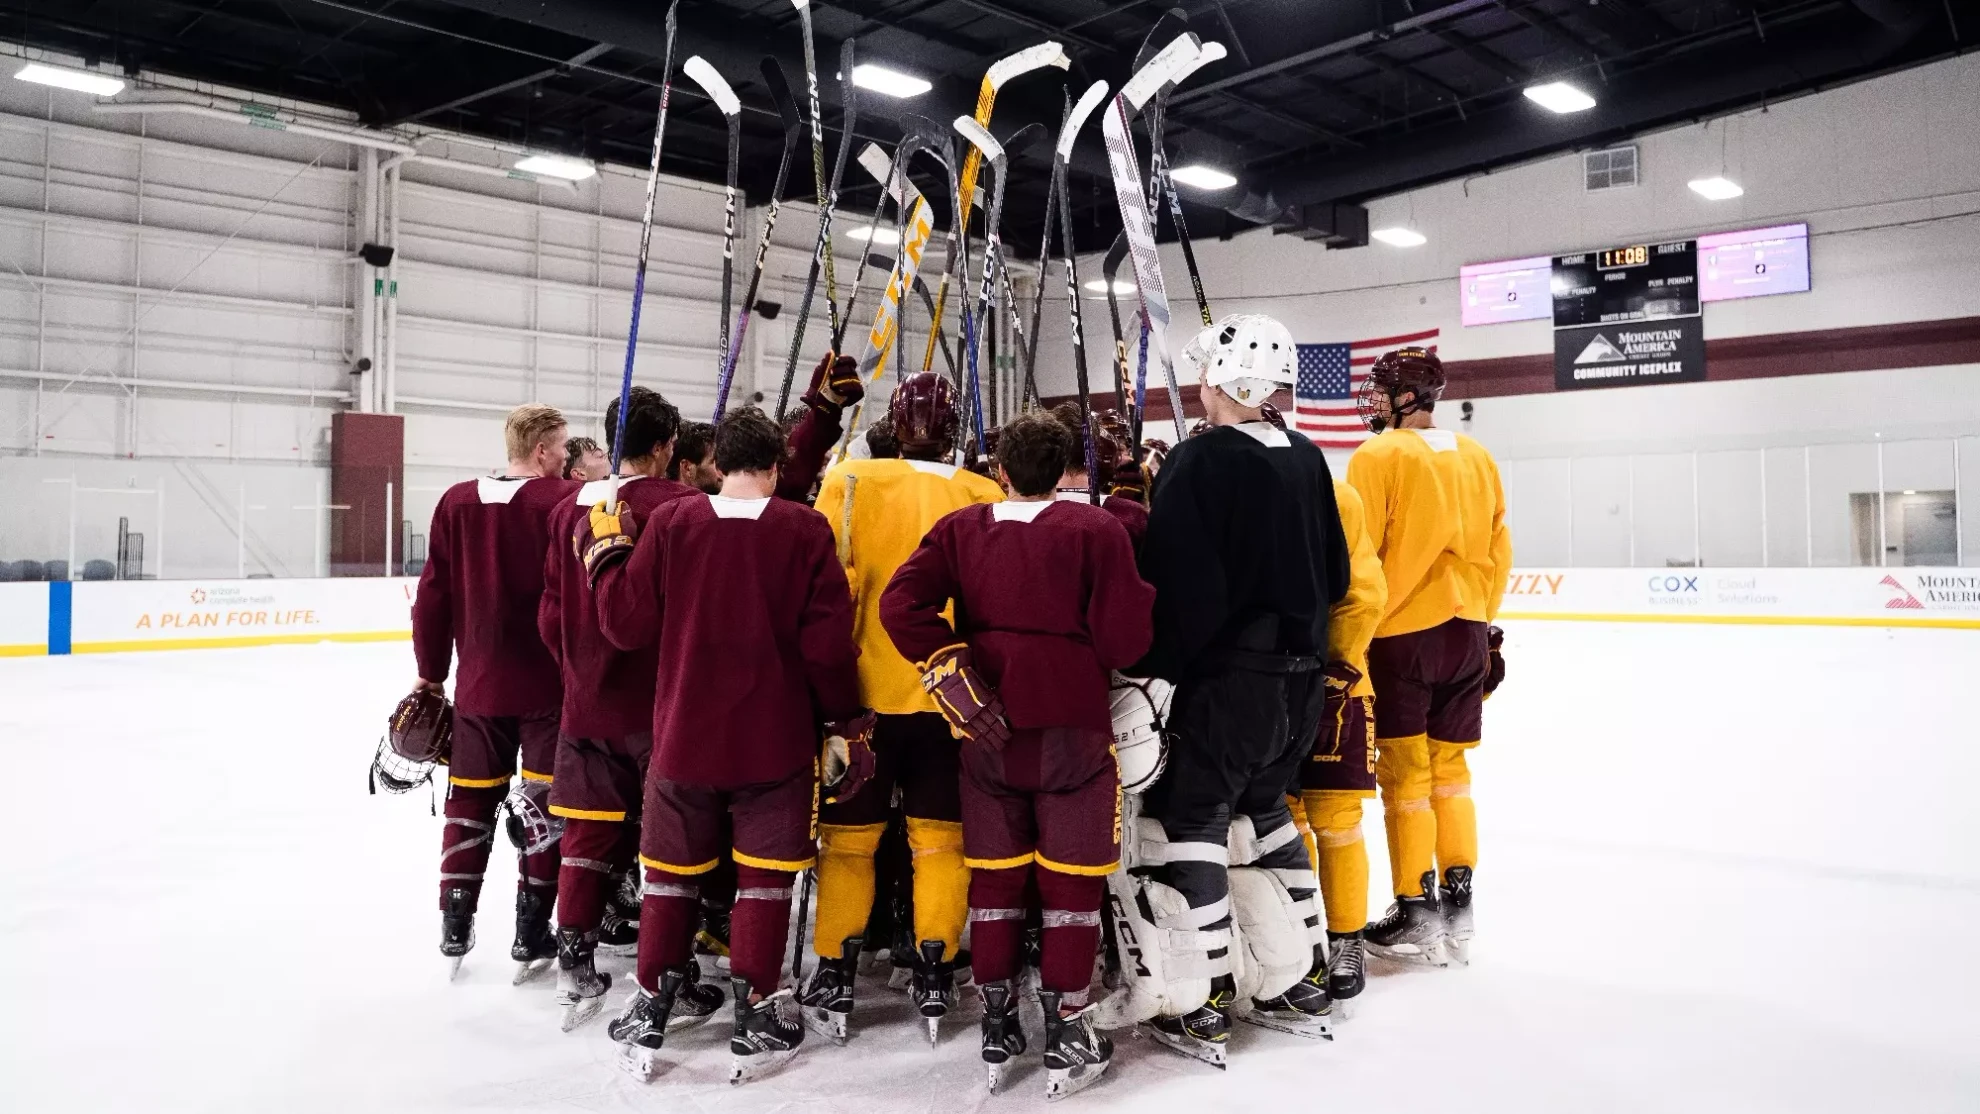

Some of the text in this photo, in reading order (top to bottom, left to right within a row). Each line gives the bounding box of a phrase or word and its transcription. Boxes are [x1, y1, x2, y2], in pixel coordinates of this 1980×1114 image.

[807, 71, 822, 142] CCM
[1149, 153, 1162, 228] CCM
[723, 185, 735, 259] CCM
[1658, 242, 1687, 254] GUEST
[1562, 255, 1586, 266] HOME
[1605, 247, 1645, 266] 11:08
[870, 217, 932, 351] CCM
[1605, 272, 1626, 281] PERIOD
[1667, 276, 1694, 286] PENALTY
[1572, 286, 1597, 295] PENALTY
[1065, 258, 1081, 345] CCM
[1618, 329, 1682, 344] MOUNTAIN
[1623, 340, 1677, 354] AMERICA
[1117, 340, 1135, 405] CCM
[1573, 361, 1682, 380] COMMUNITY ICEPLEX
[1503, 574, 1564, 595] ZZY
[1648, 576, 1698, 592] COX
[1717, 577, 1756, 590] Cloud
[1917, 574, 1980, 589] MOUNT
[136, 609, 320, 629] A PLAN FOR LIFE.
[1366, 720, 1375, 774] DEVILS
[1109, 894, 1152, 976] CCM
[843, 986, 852, 995] 10
[928, 989, 940, 999] 10
[1190, 1016, 1218, 1029] CCM
